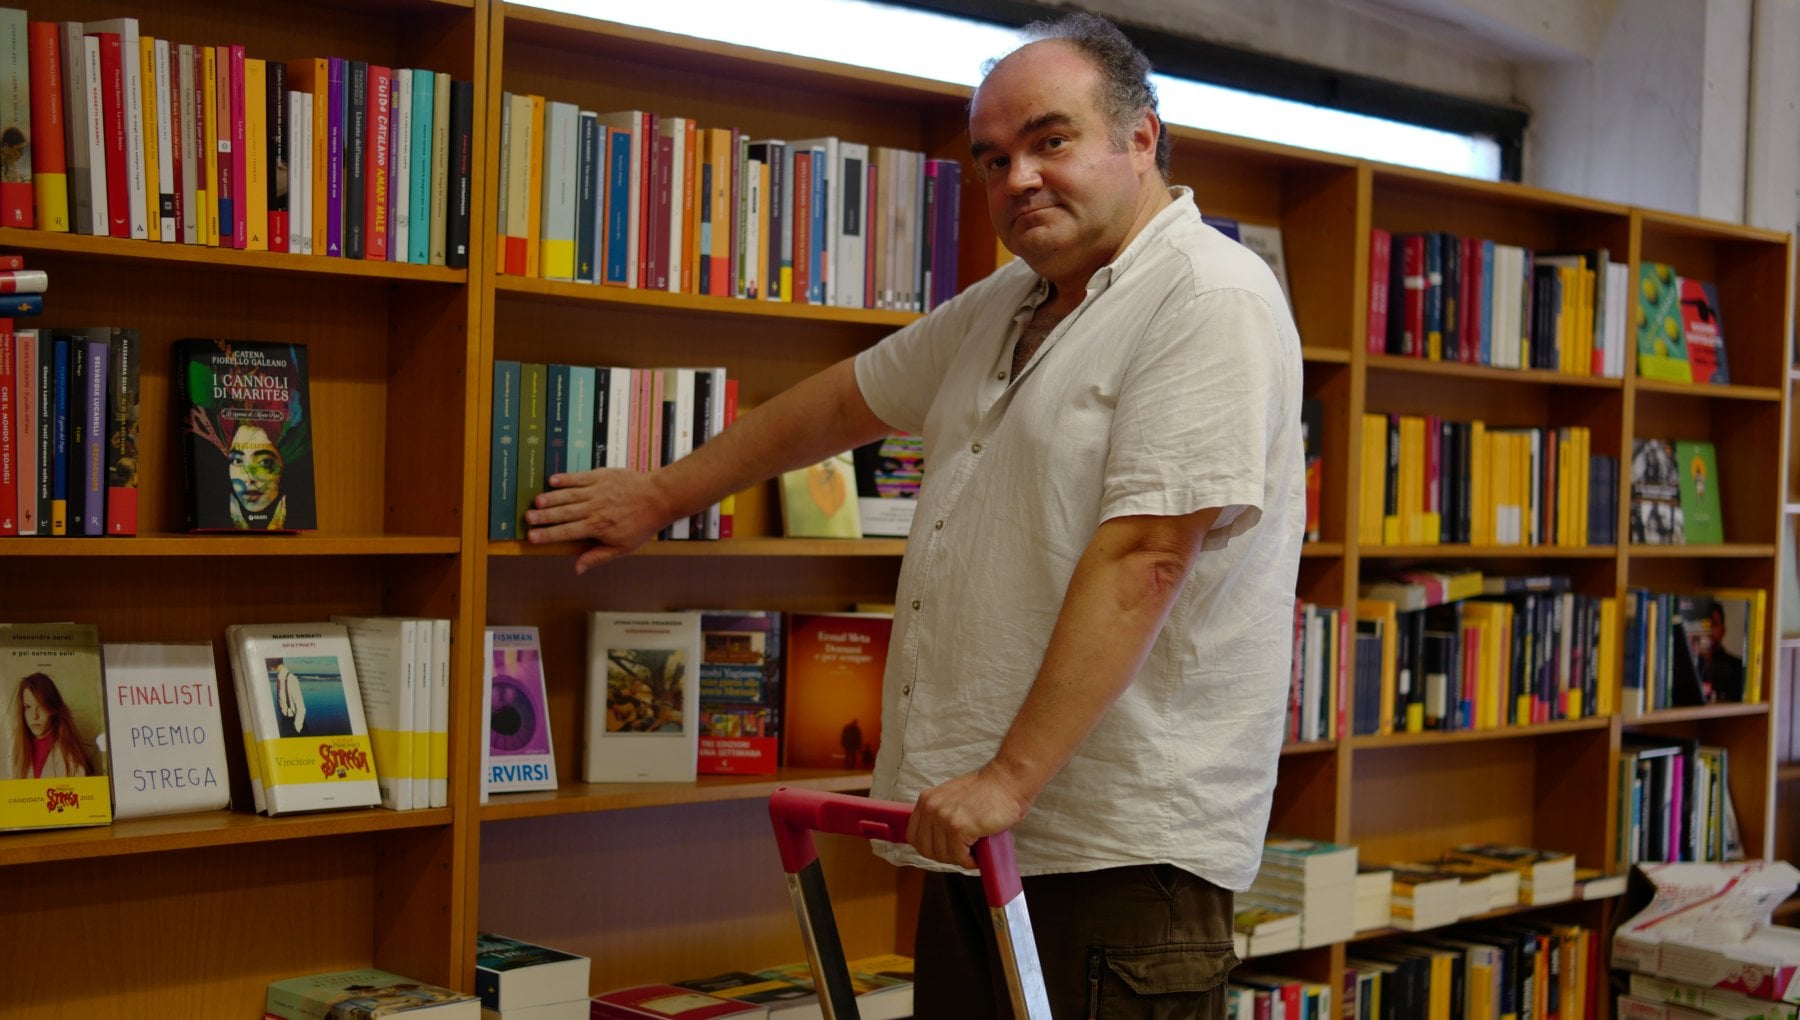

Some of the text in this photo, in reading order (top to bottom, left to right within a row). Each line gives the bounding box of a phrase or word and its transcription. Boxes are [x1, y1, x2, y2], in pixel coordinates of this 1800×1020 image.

[376, 77, 388, 232] GUIDO CATALANO AMARE MALE
[212, 356, 287, 367] FIORELLO GALEANO
[235, 350, 265, 359] CATENA
[93, 356, 101, 396] SELVAGGIA
[213, 373, 288, 389] I CANNOLI
[213, 387, 289, 402] DI MARITES
[92, 443, 100, 492] CREPACUORE
[493, 633, 533, 641] FISHMAN
[18, 650, 30, 658] poi
[118, 684, 213, 707] FINALISTI
[131, 726, 206, 748] PREMIO
[275, 743, 370, 780] Vincitore STREGA
[134, 767, 217, 792] STREGA
